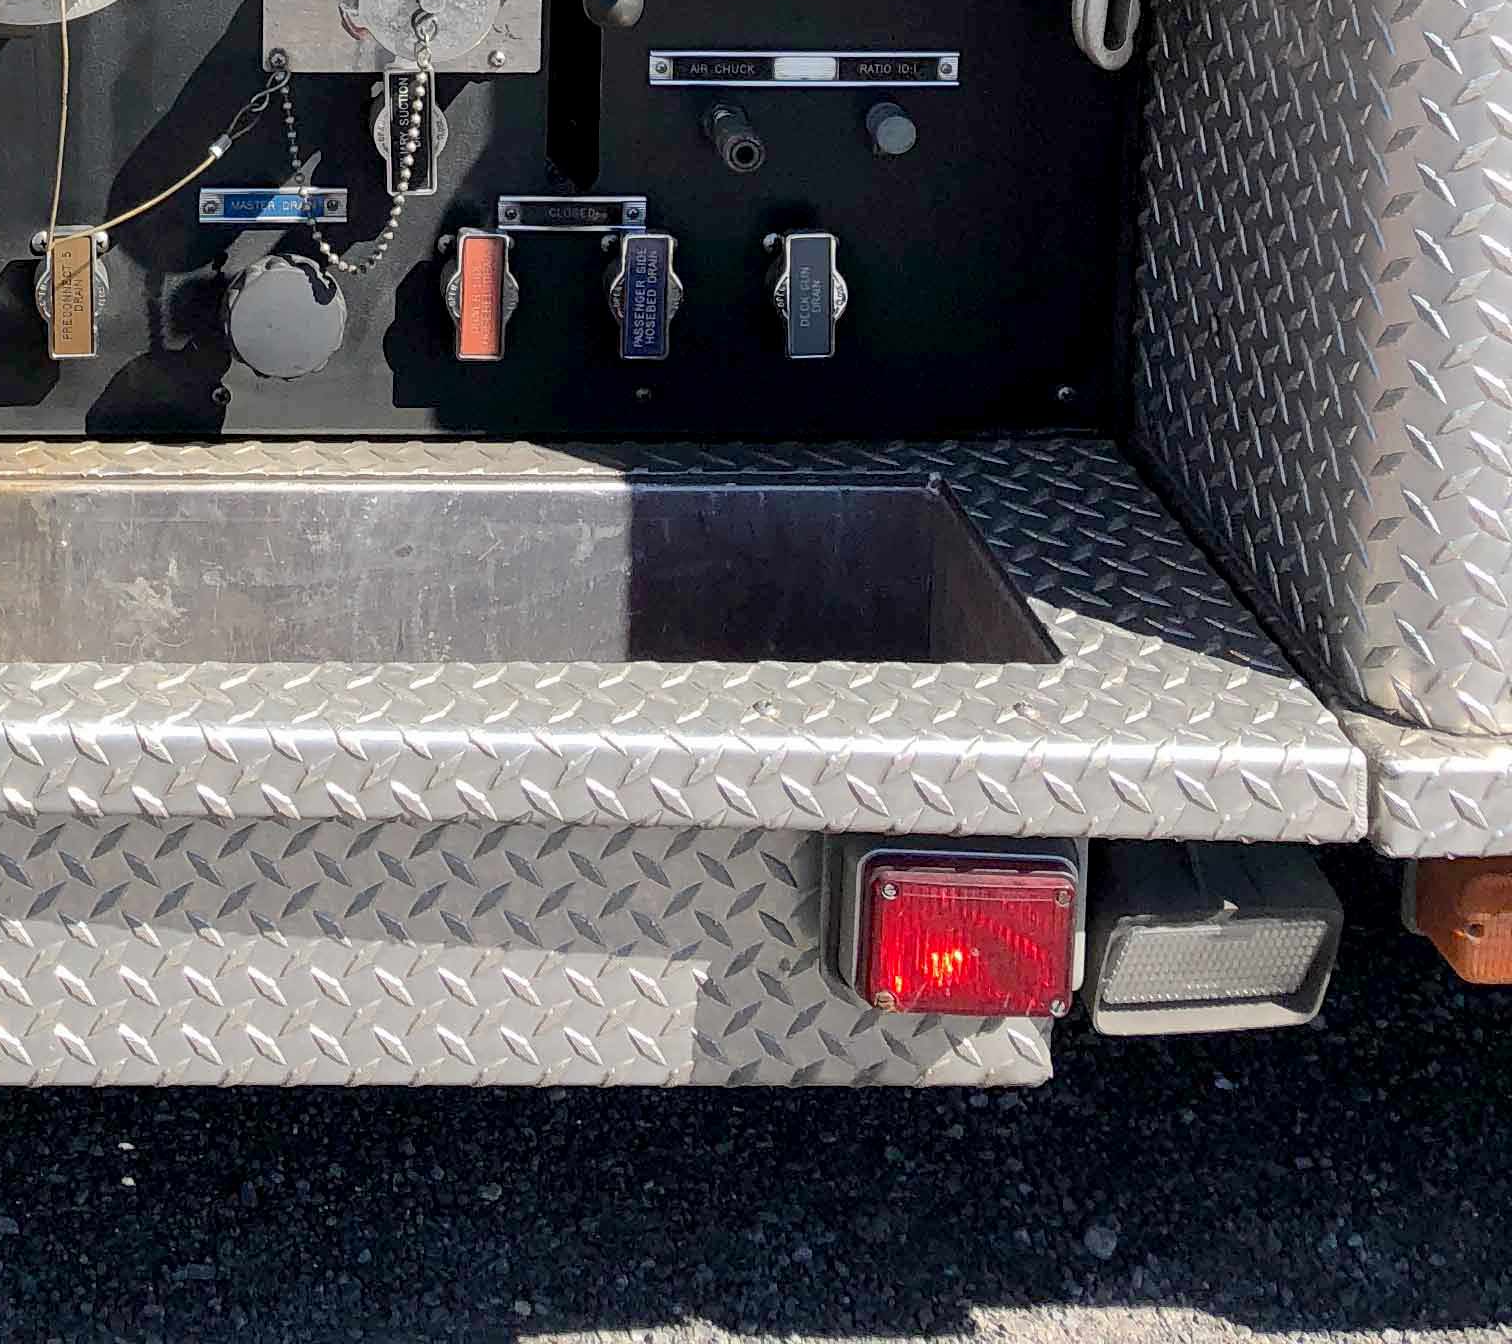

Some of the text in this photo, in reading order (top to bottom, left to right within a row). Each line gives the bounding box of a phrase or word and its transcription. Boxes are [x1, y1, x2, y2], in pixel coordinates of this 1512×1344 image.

[690, 64, 892, 75] AIR CHUCK RATIO
[398, 76, 409, 126] SUCTION
[231, 200, 276, 210] MASTER
[62, 263, 73, 342] PRECONNECT
[74, 278, 84, 312] DRAIN
[633, 247, 648, 348] PASSENGER SIDE
[645, 250, 658, 344] HOSEBED DRAIN
[800, 266, 810, 328] DECK GUN
[812, 280, 822, 312] DRAIN
